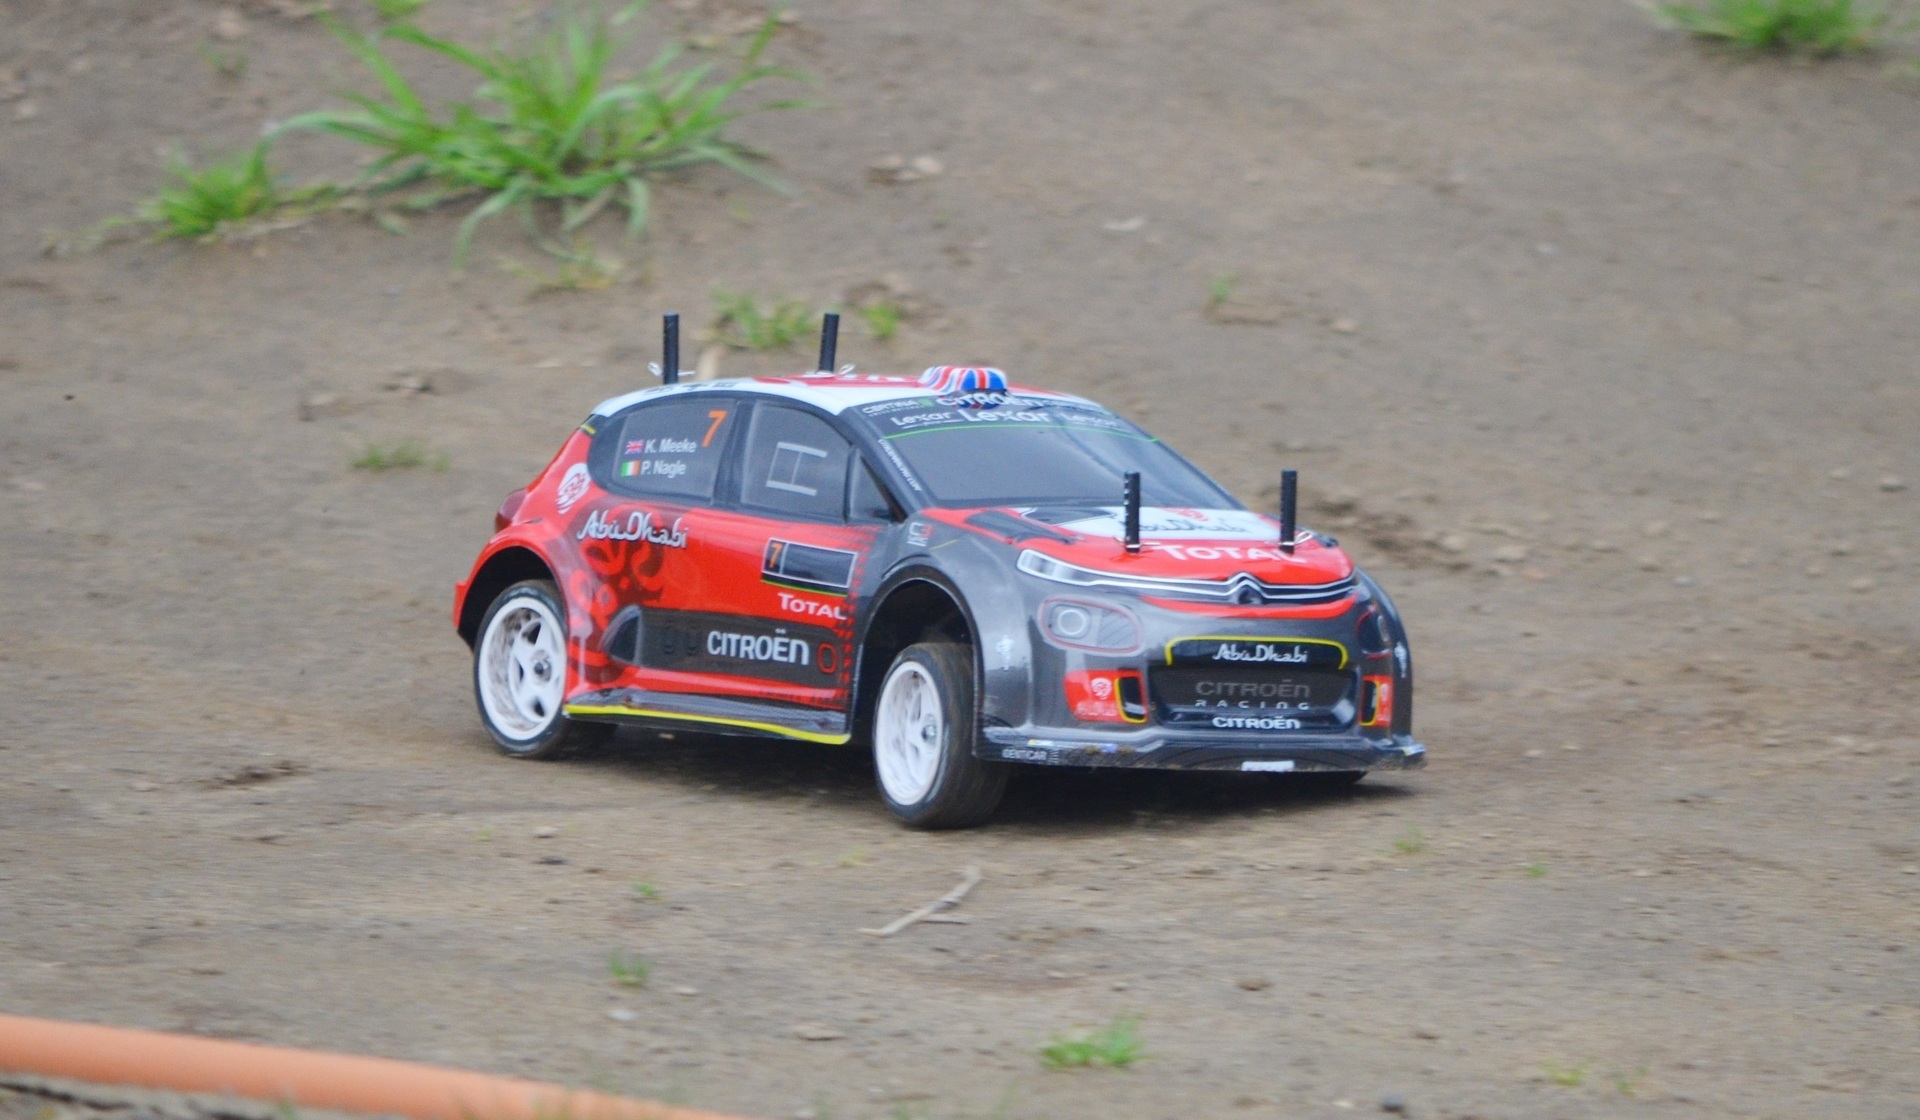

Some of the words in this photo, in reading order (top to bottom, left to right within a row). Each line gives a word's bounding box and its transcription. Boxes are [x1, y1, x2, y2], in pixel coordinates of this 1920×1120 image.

[890, 411, 952, 425] Lexar
[957, 409, 1050, 422] Lexar
[702, 410, 728, 448] 7
[644, 439, 656, 454] K.
[659, 438, 697, 453] Meeke
[640, 460, 651, 475] P.
[653, 460, 687, 479] Nagle
[769, 543, 783, 568] 7
[1151, 544, 1306, 563] TOTAL
[777, 592, 848, 620] TOTAL
